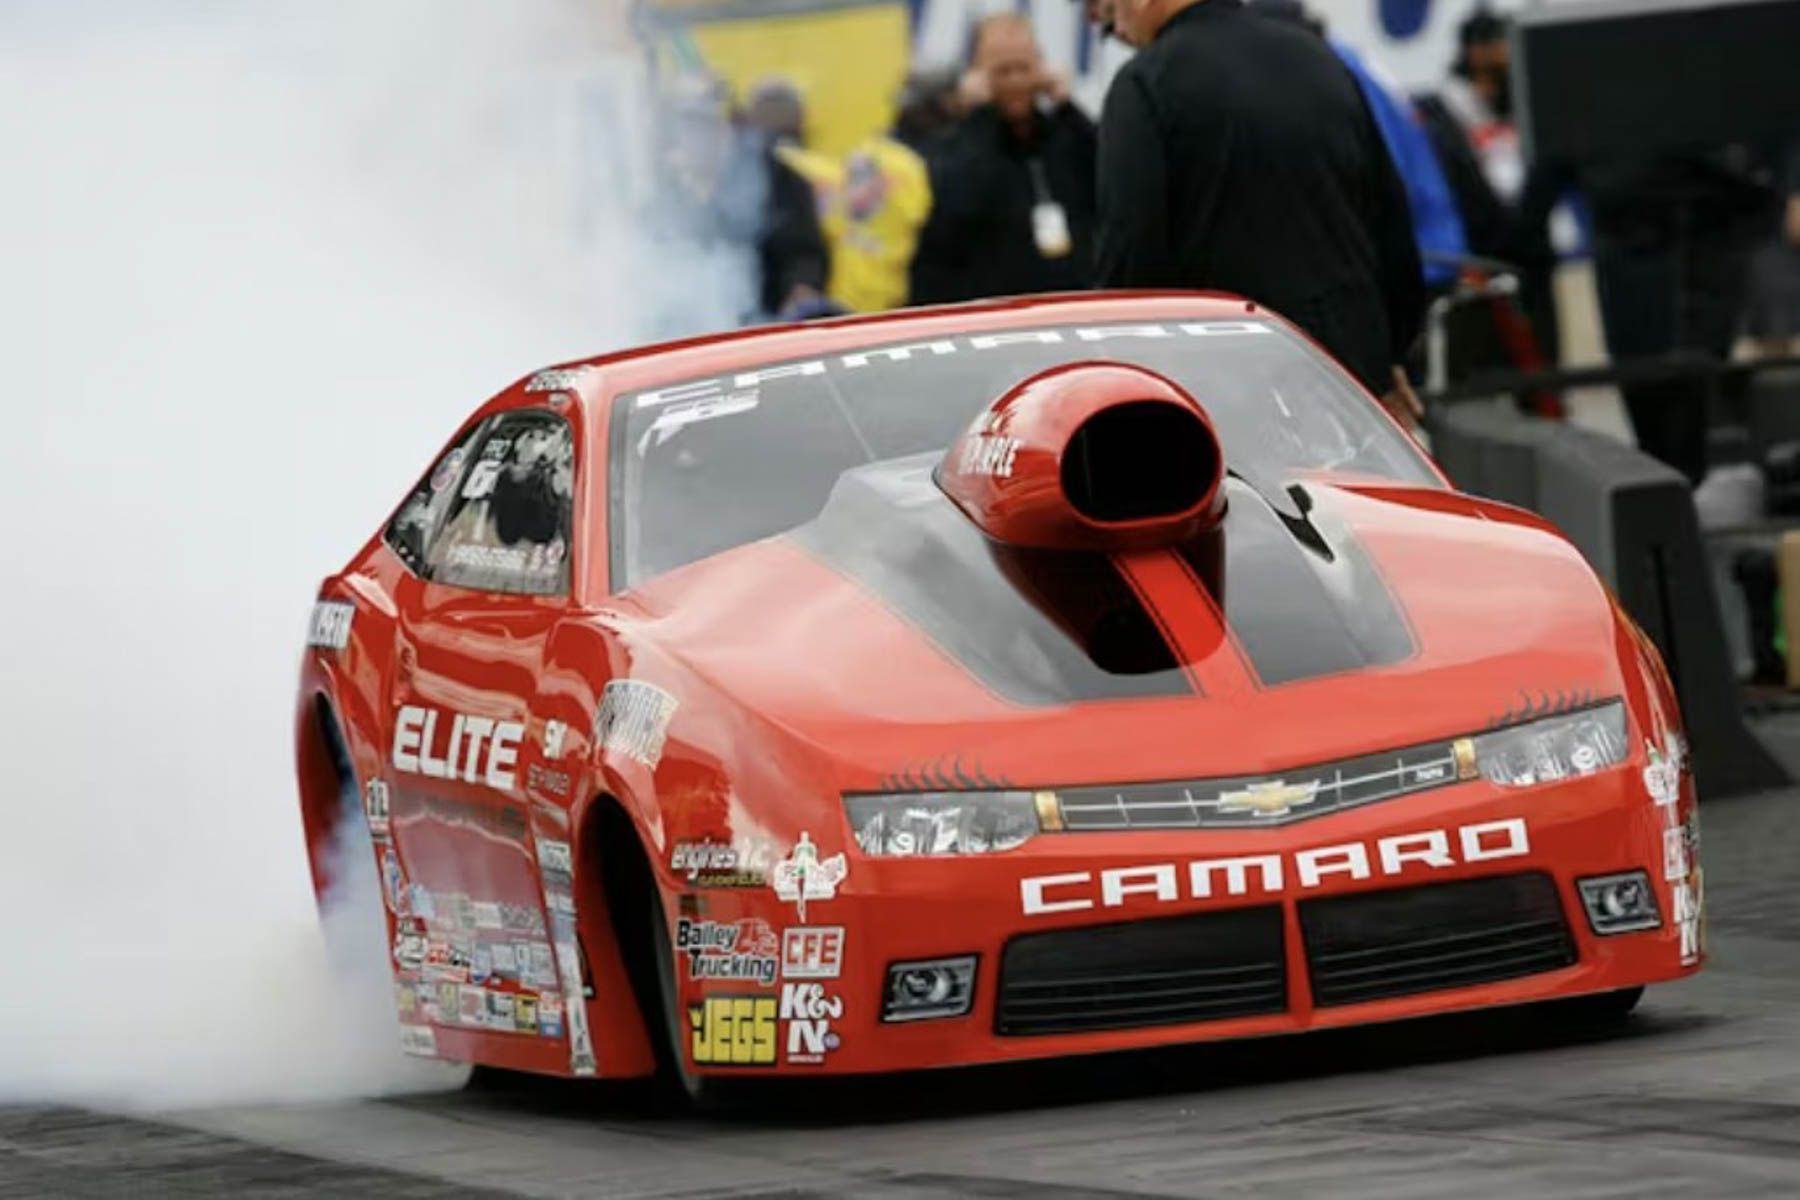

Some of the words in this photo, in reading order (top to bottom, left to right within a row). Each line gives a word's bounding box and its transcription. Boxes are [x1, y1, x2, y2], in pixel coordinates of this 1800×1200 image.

[393, 705, 525, 790] ELITE
[1021, 818, 1529, 916] CAMARO
[676, 920, 738, 950] Bailey
[786, 933, 837, 966] CFE
[688, 949, 777, 984] Trucking
[780, 982, 842, 1019] K&
[689, 998, 777, 1064] JEGS
